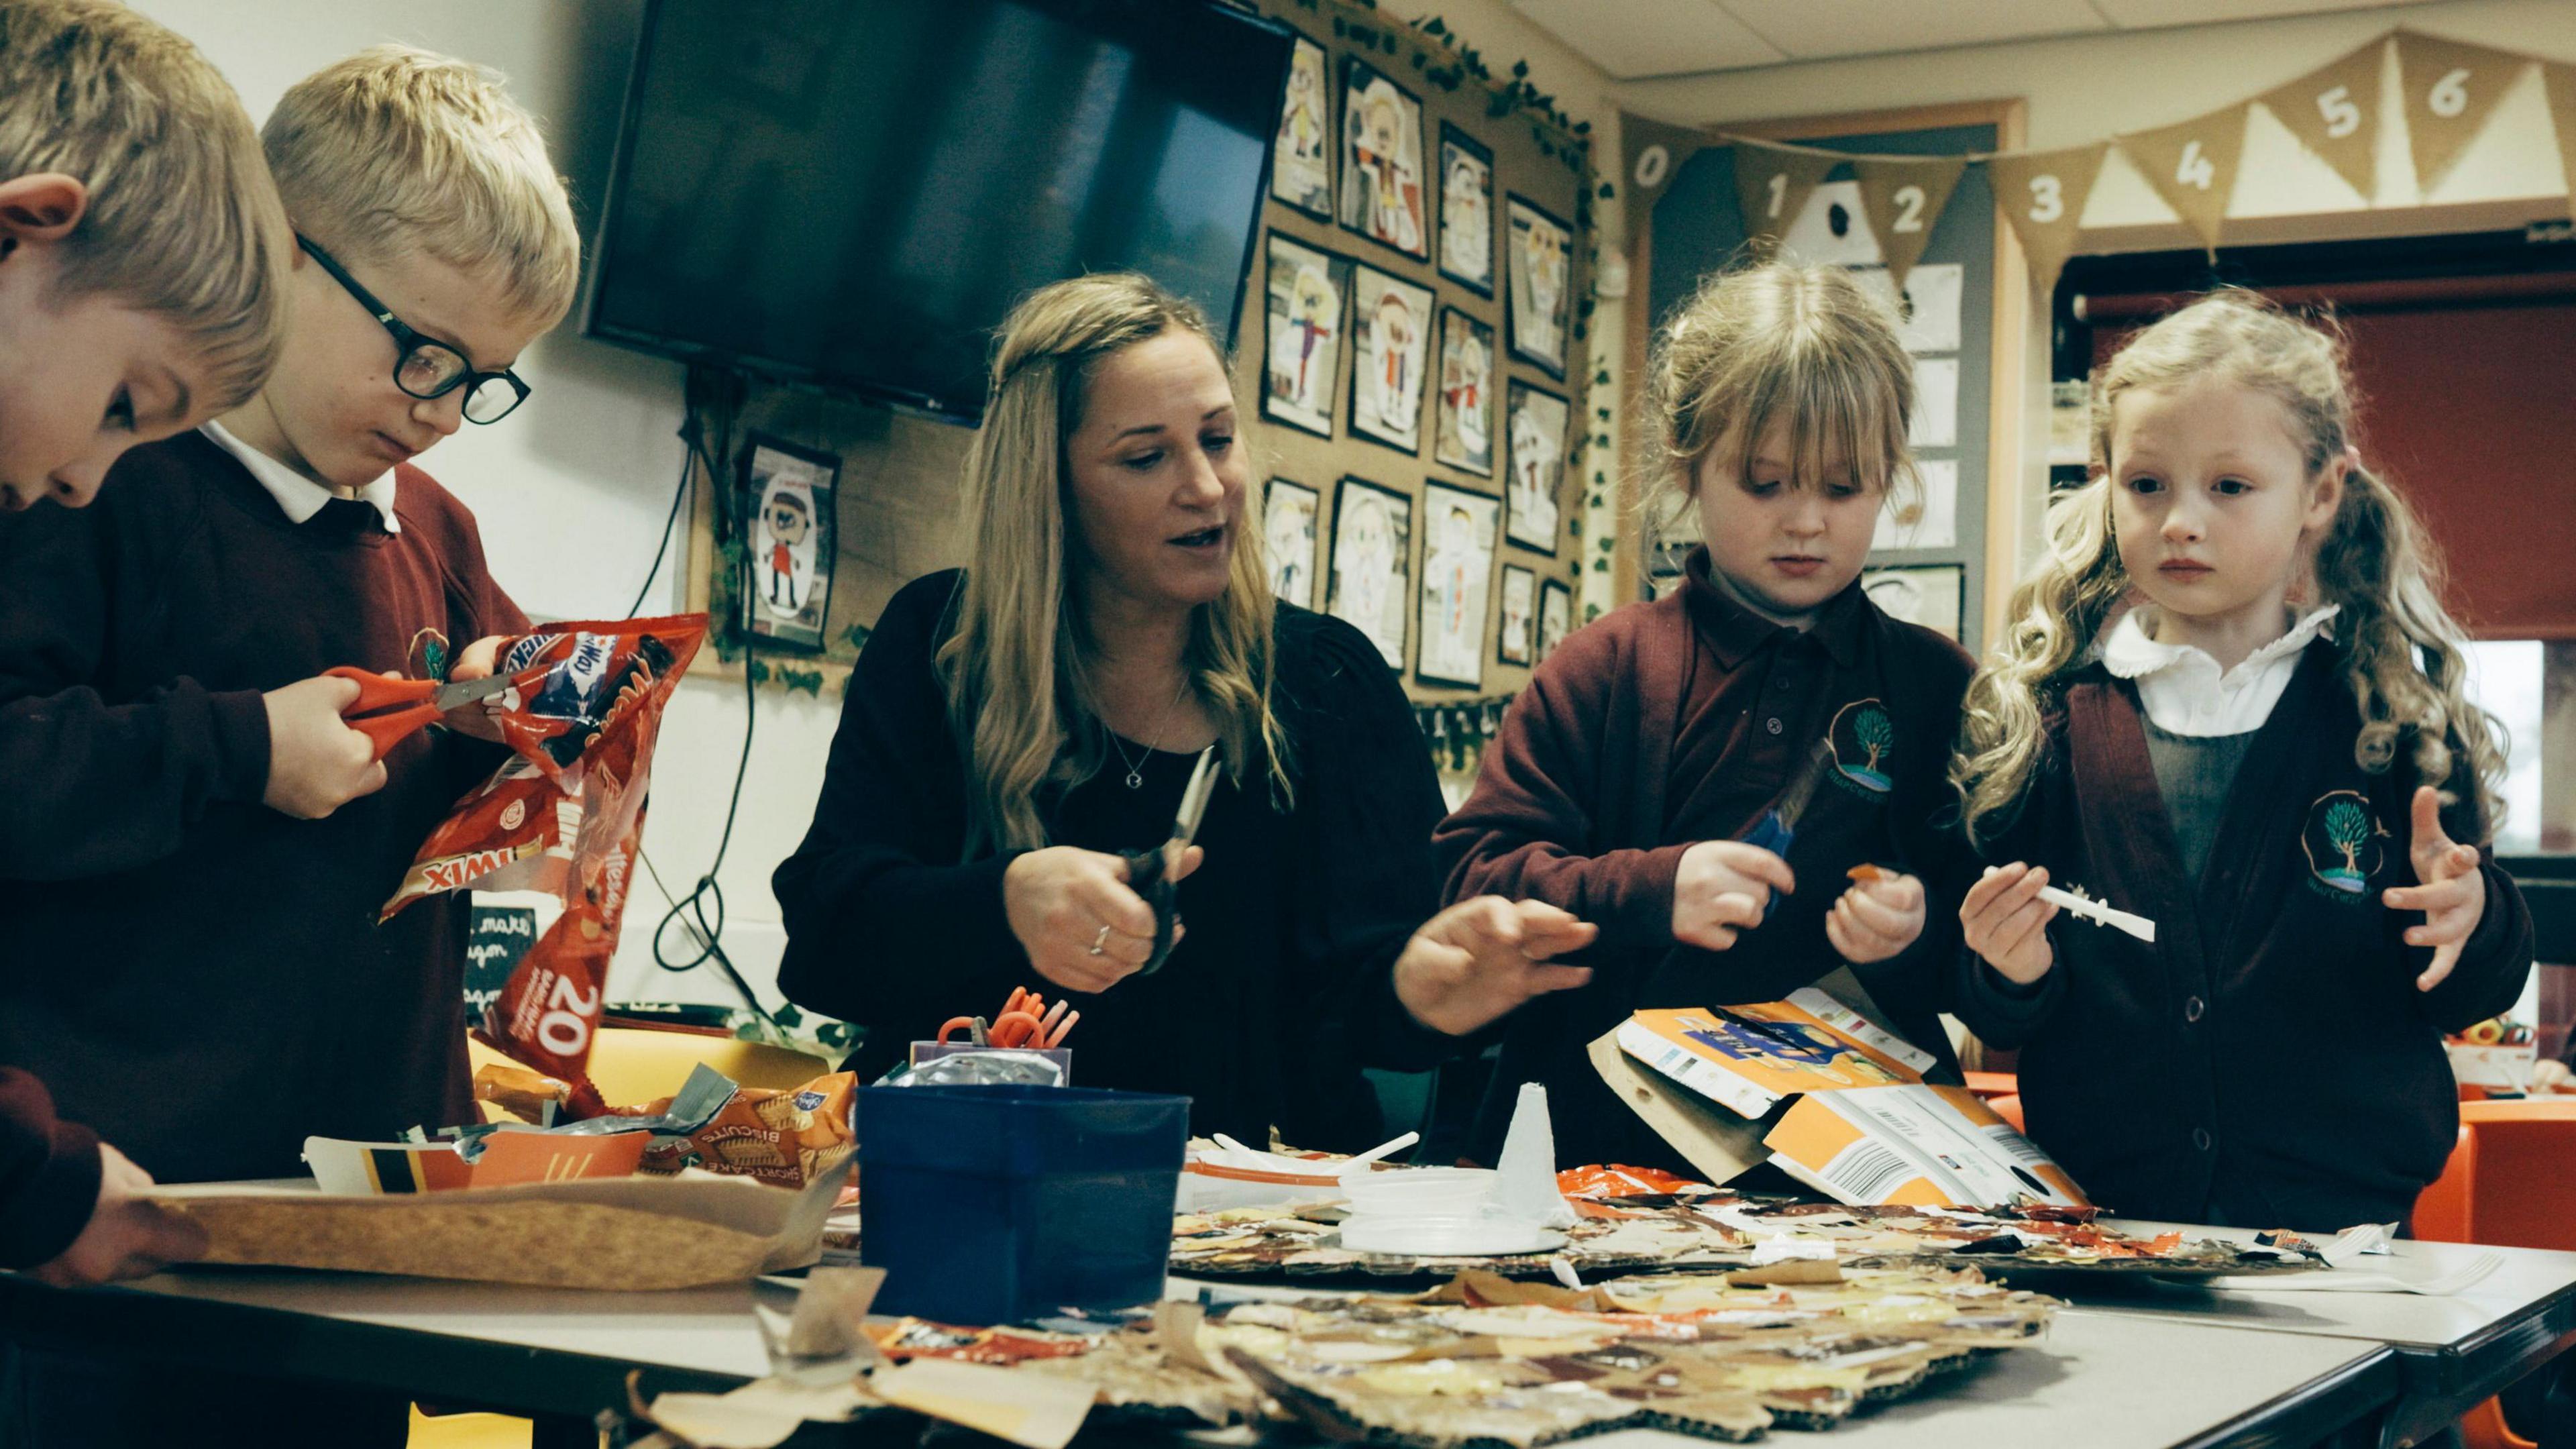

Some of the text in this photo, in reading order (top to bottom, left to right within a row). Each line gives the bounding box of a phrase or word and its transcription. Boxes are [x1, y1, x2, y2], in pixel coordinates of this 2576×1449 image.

[2316, 86, 2361, 138] 5
[2428, 68, 2472, 117] 6
[1635, 146, 1669, 187] 0
[2176, 141, 2215, 190] 4
[1767, 174, 1788, 219] 1
[1893, 186, 1926, 233] 2
[2029, 176, 2063, 224] 3
[574, 644, 602, 676] Way
[479, 914, 531, 937] make
[537, 974, 598, 1057] 20
[702, 1126, 781, 1144] BISCUITS
[708, 1161, 800, 1181] SHORTCAKE
